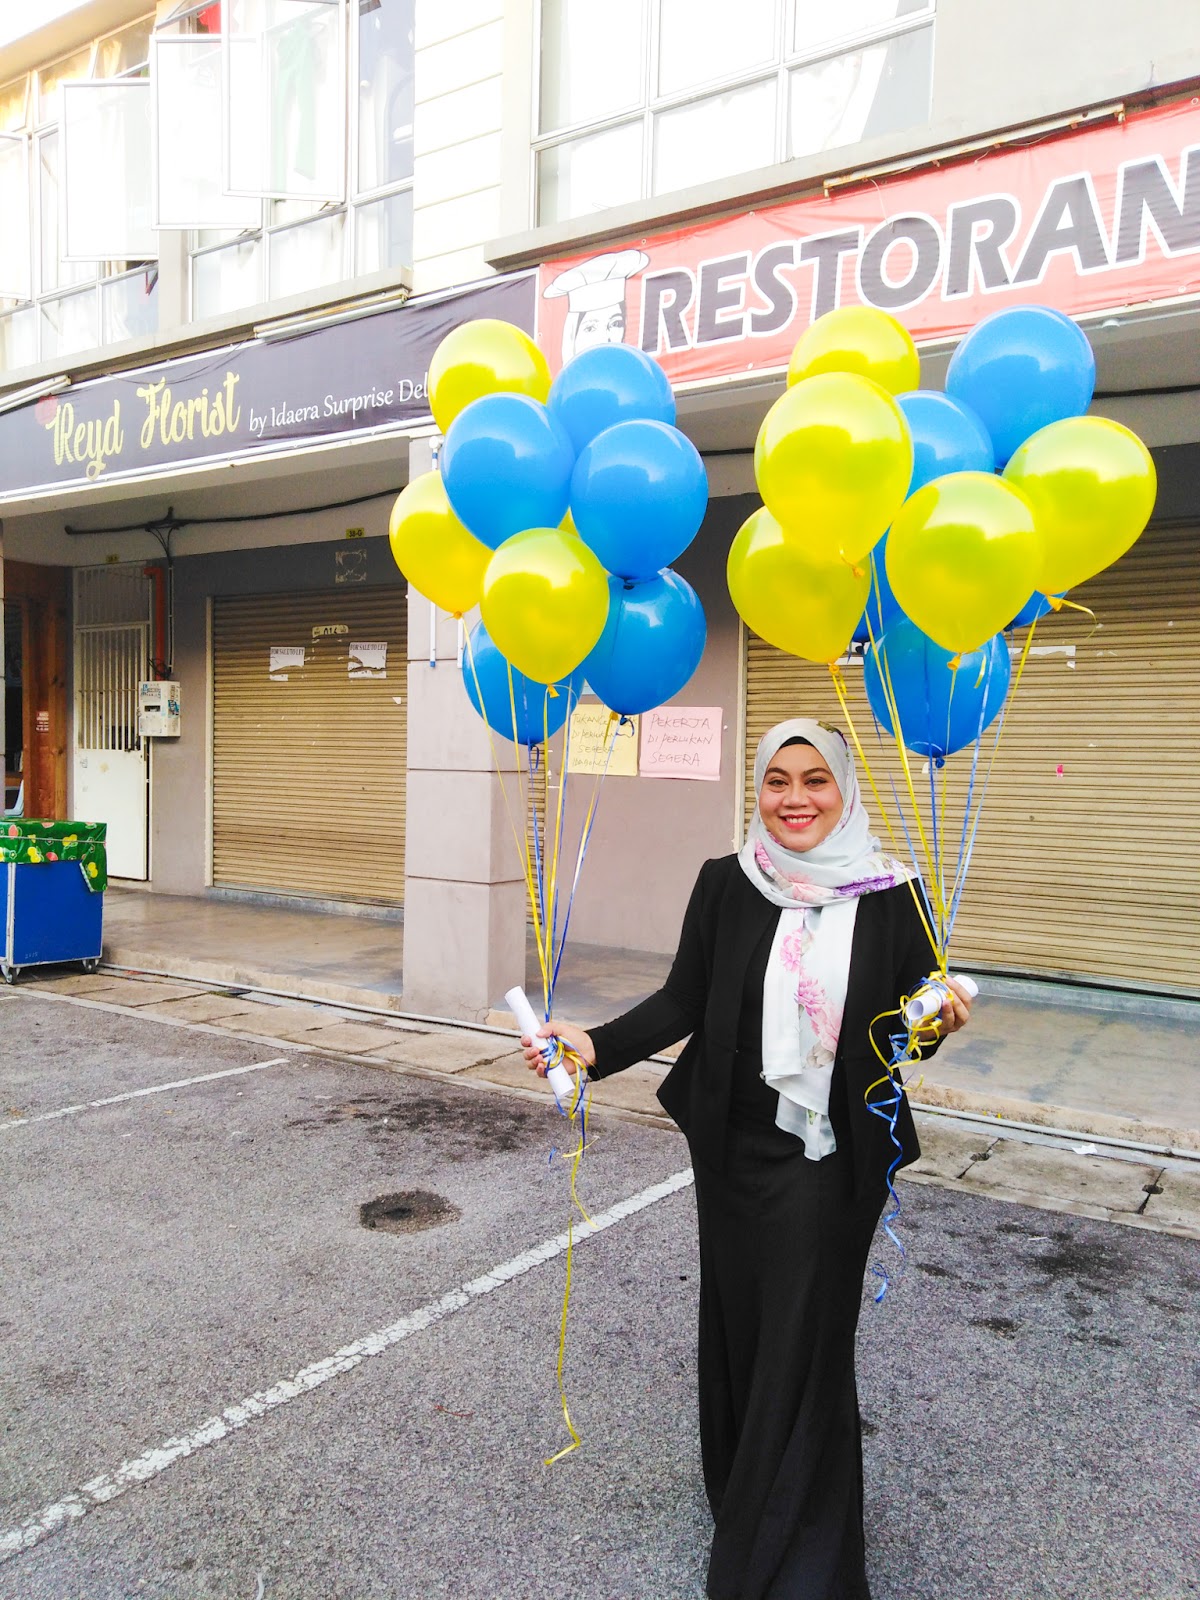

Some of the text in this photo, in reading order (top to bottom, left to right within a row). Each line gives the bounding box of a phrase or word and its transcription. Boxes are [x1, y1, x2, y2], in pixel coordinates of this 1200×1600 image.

[639, 143, 1200, 356] RESTORAN
[46, 371, 241, 481] Reyd Florist
[249, 408, 268, 438] by
[271, 401, 320, 427] Idaera
[323, 386, 394, 420] Surprise
[650, 713, 711, 730] PEKERJA
[648, 751, 701, 767] SEGERA
